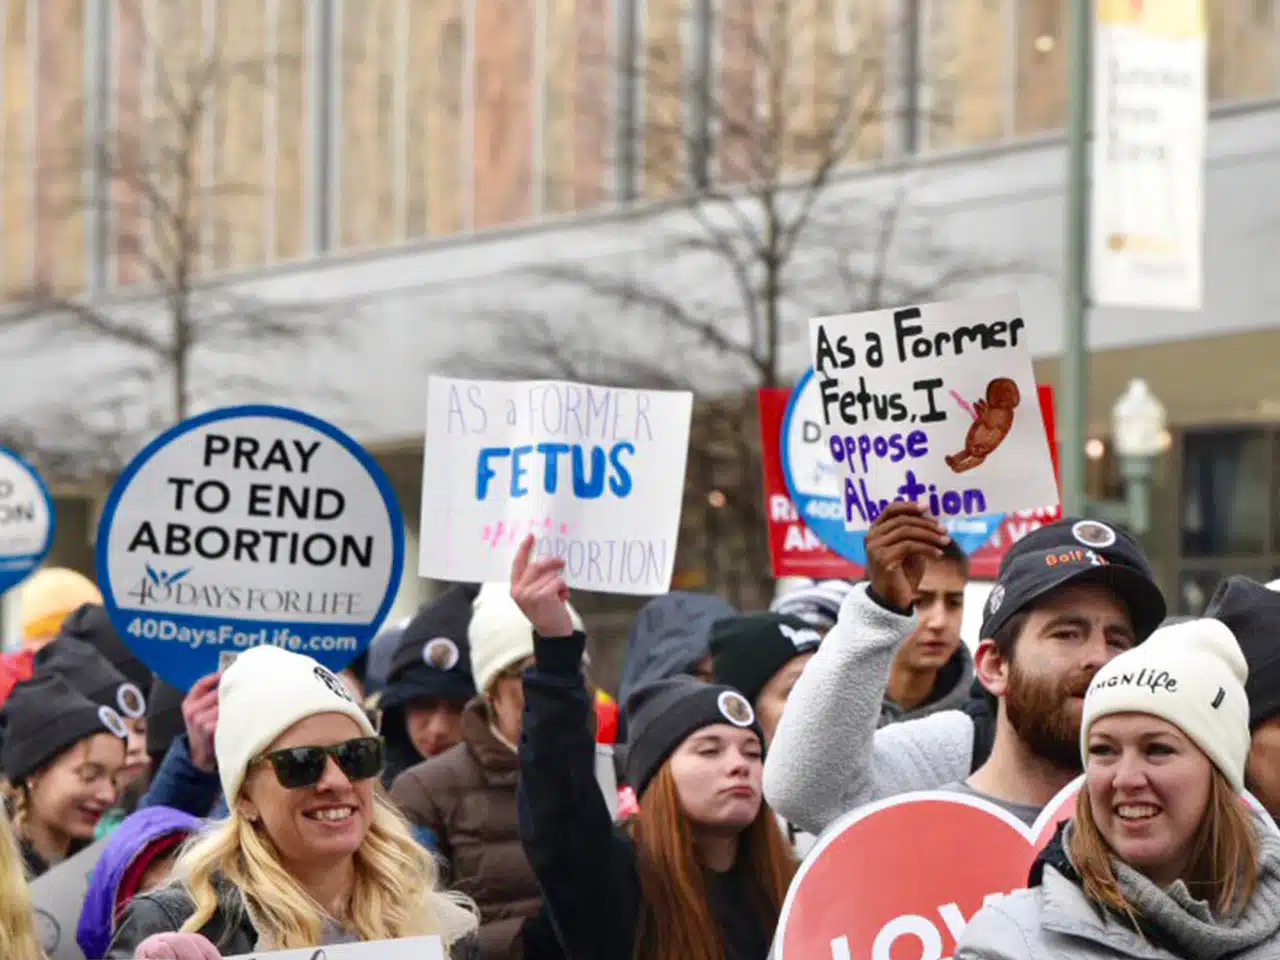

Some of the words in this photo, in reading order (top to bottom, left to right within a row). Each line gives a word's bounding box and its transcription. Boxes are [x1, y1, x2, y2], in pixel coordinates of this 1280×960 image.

[816, 325, 856, 371] As
[866, 332, 883, 368] a
[894, 307, 1025, 362] Former
[528, 383, 653, 441] FORMER
[820, 376, 917, 425] Fetus,
[913, 378, 947, 422] I
[202, 434, 321, 474] PRAY
[475, 441, 636, 501] FETUS
[167, 477, 231, 514] TO
[247, 484, 346, 521] END
[844, 471, 987, 523] Abtion
[127, 521, 374, 569] ABORTION
[127, 616, 358, 651] 40DaysForLife.com
